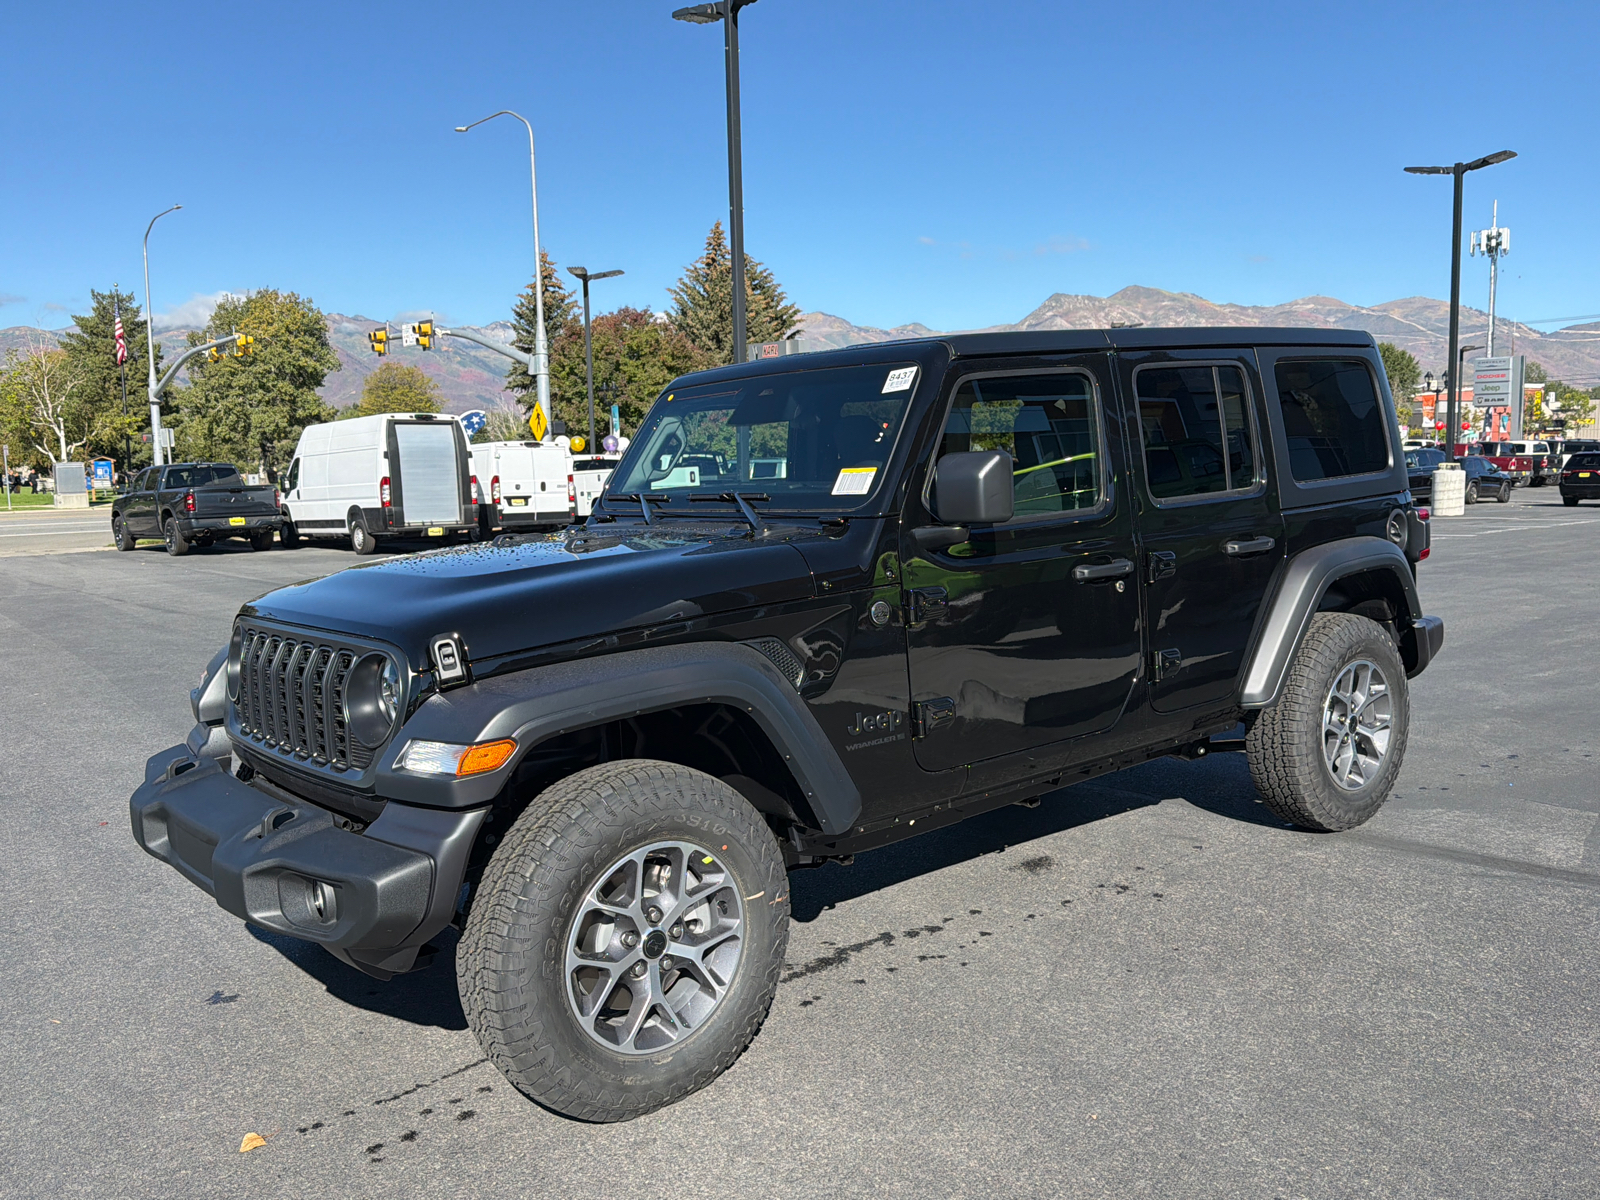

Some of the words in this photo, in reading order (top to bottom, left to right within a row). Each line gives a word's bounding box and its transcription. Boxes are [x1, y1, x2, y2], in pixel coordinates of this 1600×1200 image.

[889, 370, 914, 381] 8437
[1481, 384, 1501, 392] Jeep
[847, 710, 902, 736] Jeep
[845, 735, 896, 752] WRANGLER
